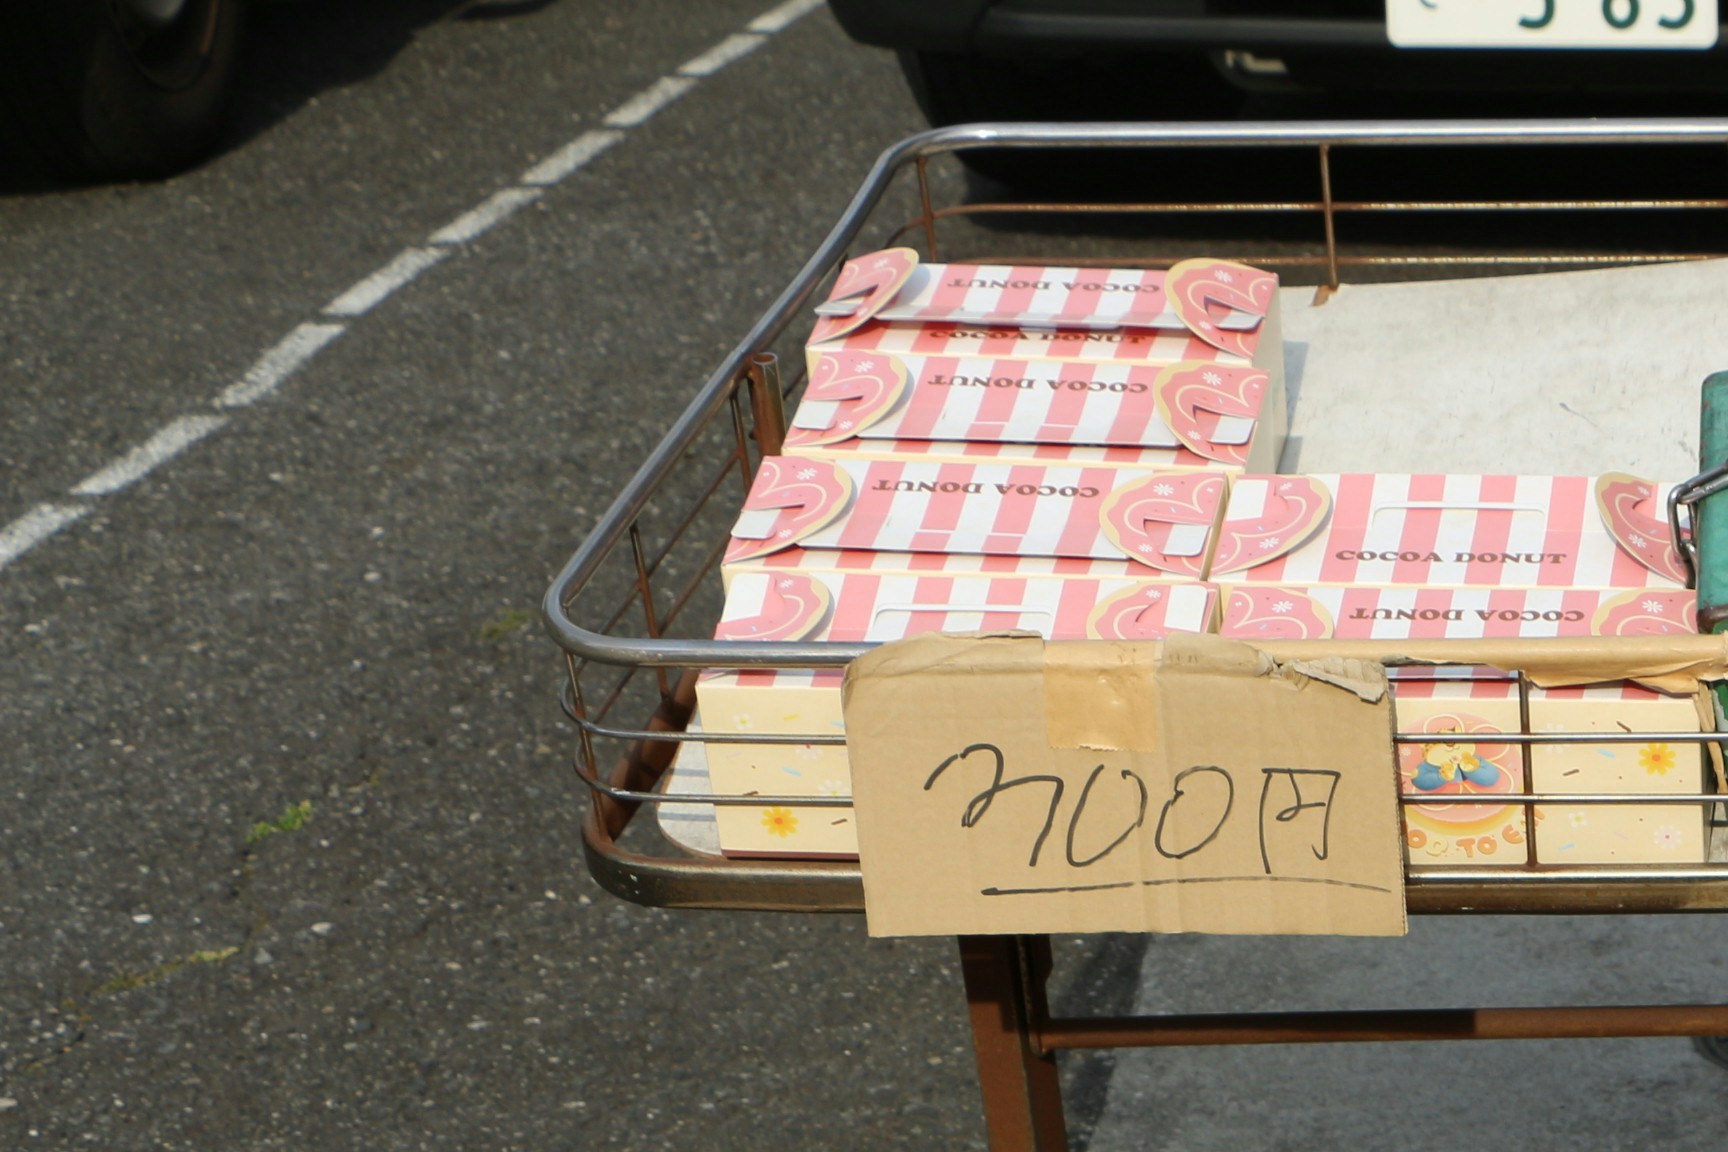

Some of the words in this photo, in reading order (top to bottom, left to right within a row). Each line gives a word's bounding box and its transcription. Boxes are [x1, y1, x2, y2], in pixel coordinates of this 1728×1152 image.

[947, 278, 1052, 290] DONUT
[1063, 281, 1160, 293] COCOA
[929, 330, 1029, 341] COCOA
[1038, 331, 1146, 344] DONUT
[927, 375, 1037, 390] DONUT
[1046, 379, 1149, 394] COCOA
[872, 479, 985, 495] DONUT
[993, 482, 1100, 498] COCOA
[1335, 550, 1443, 563] COCOA
[1452, 552, 1567, 564] DONUT
[1348, 607, 1465, 621] DONUT
[1475, 609, 1585, 622] COCOA
